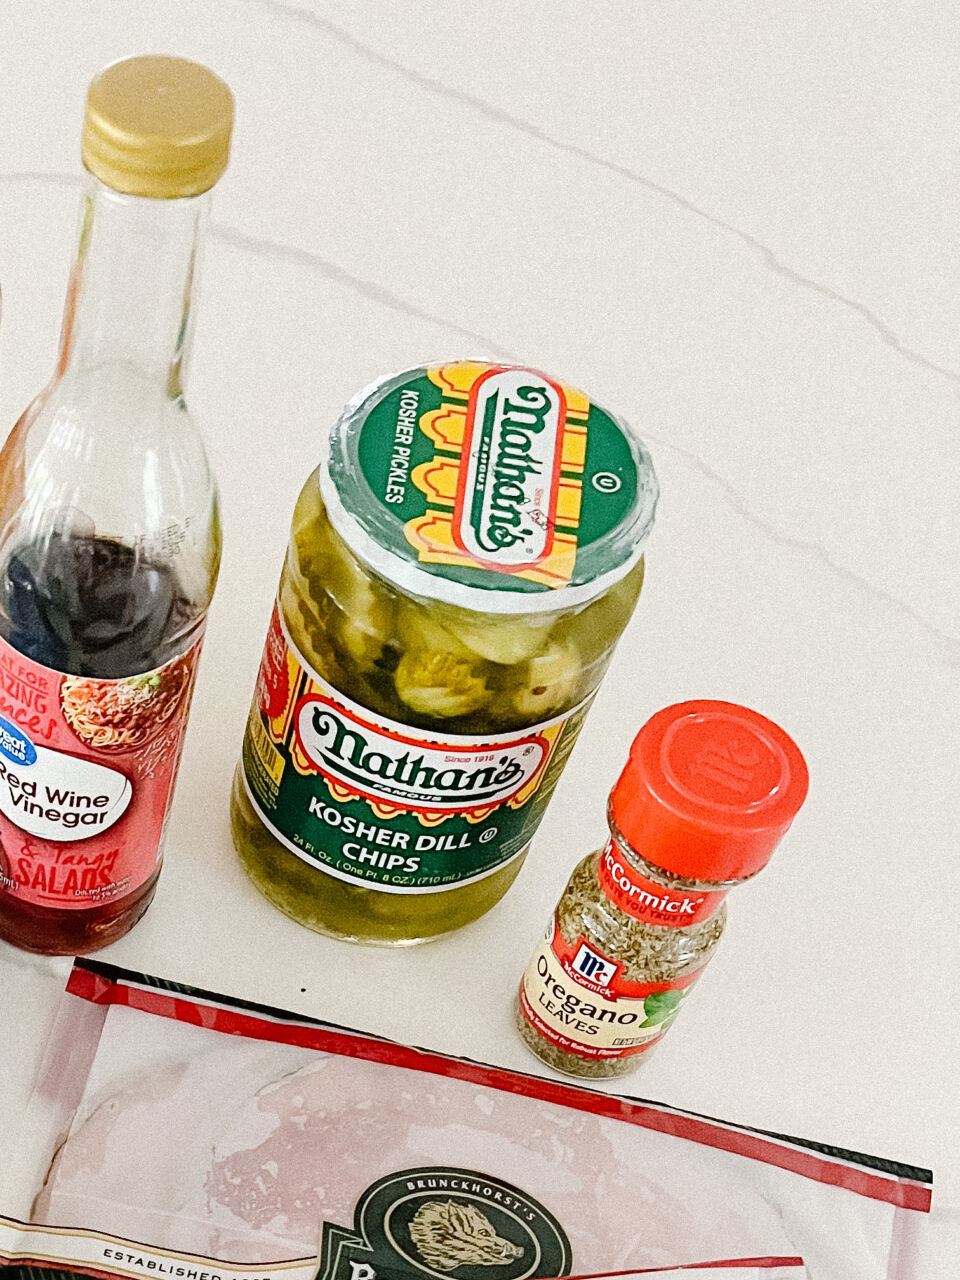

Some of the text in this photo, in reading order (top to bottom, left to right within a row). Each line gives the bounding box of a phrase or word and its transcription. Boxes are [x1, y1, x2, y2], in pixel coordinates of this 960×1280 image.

[384, 389, 420, 504] KOSHER PICKLES
[473, 436, 491, 493] FAMOUS
[487, 385, 552, 552] Nathan's
[18, 665, 49, 690] FOR
[0, 738, 27, 761] Value
[312, 707, 525, 791] Nathan's
[8, 787, 108, 829] Vinegar
[45, 786, 110, 809] Wine
[372, 783, 443, 801] FAMOUS
[309, 797, 410, 849] KOSHER
[415, 829, 472, 851] DILL
[342, 842, 421, 873] CHIPS
[537, 955, 638, 1025] Oregano
[564, 961, 614, 997] McCormick
[538, 992, 600, 1035] LEAVES
[406, 1179, 538, 1221] BRUNCKHORST'S
